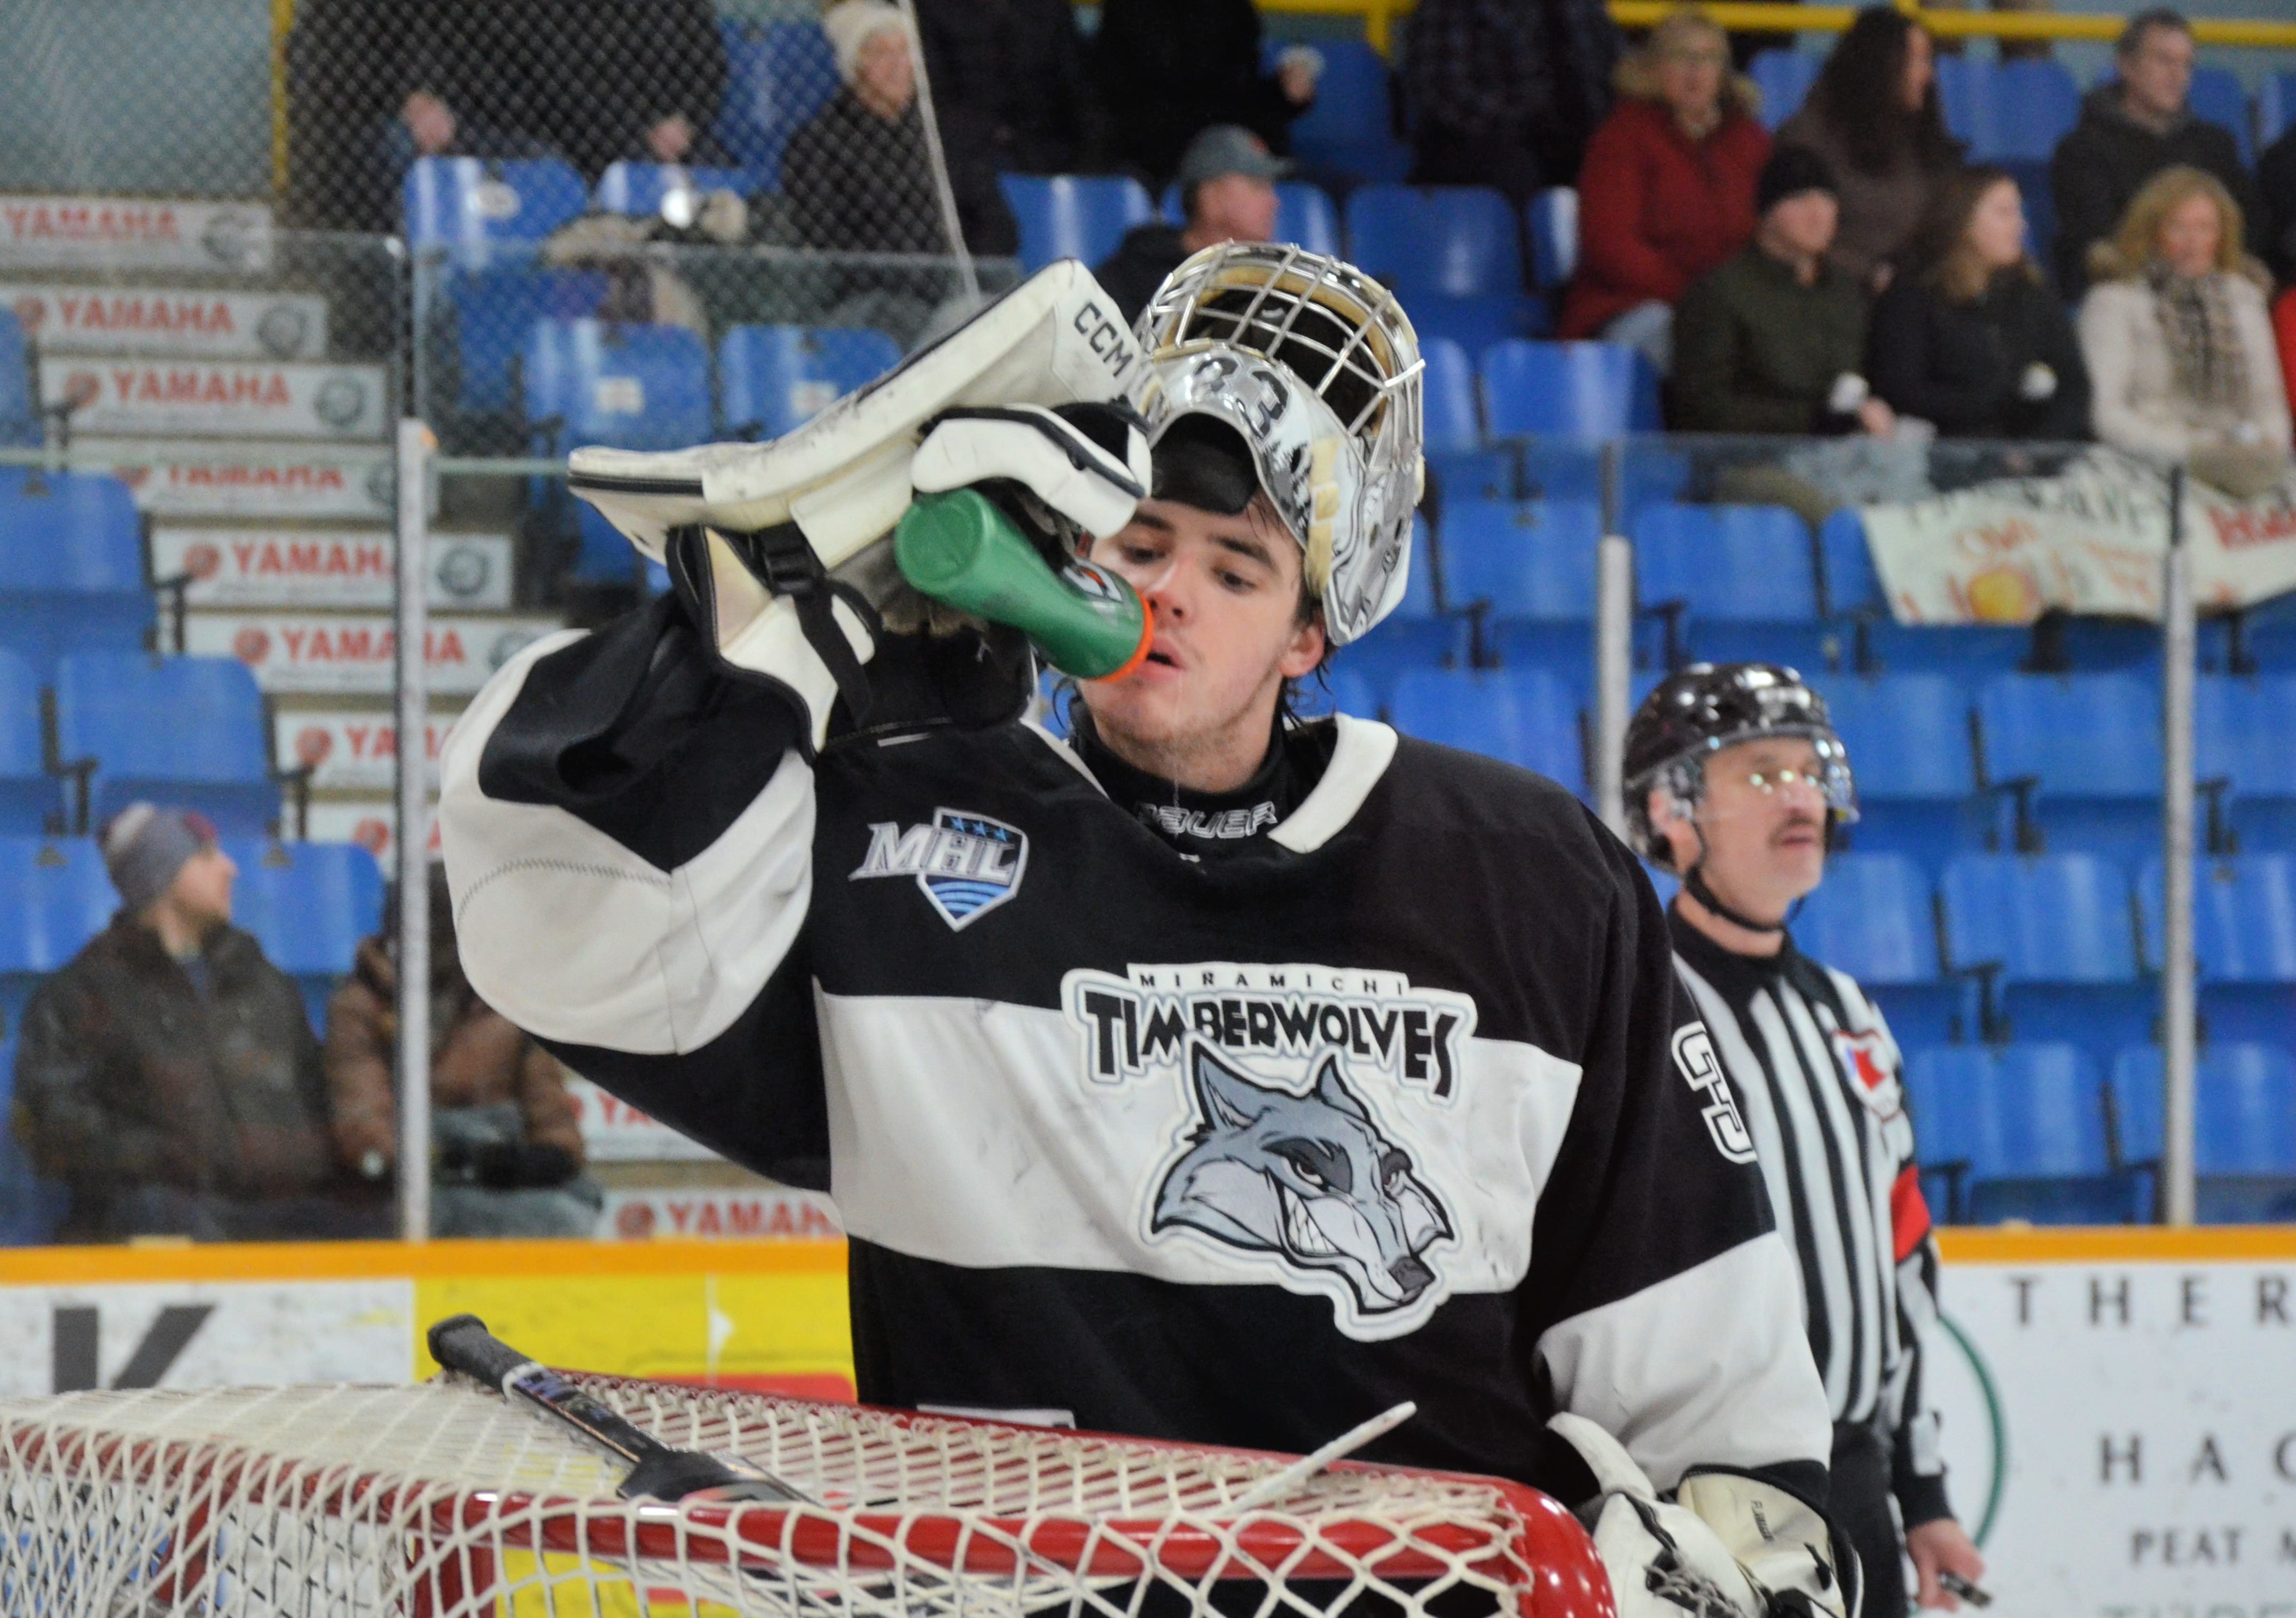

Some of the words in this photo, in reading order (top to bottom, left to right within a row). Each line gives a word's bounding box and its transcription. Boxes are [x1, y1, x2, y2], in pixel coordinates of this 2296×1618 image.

[7, 204, 181, 243] YAMAHA
[58, 295, 236, 334] YAMAHA
[1072, 301, 1134, 379] CCM
[112, 369, 292, 407] YAMAHA
[232, 543, 395, 577] YAMAH
[279, 628, 466, 666] YAMAA
[848, 820, 1017, 882] MHL
[1139, 970, 1406, 996] MIRAMICHI
[1084, 990, 1459, 1099] TIMBERWOLVES
[667, 1200, 834, 1236] YAMAH
[2007, 1273, 2290, 1327] THER
[2128, 1525, 2246, 1567] PEAT
